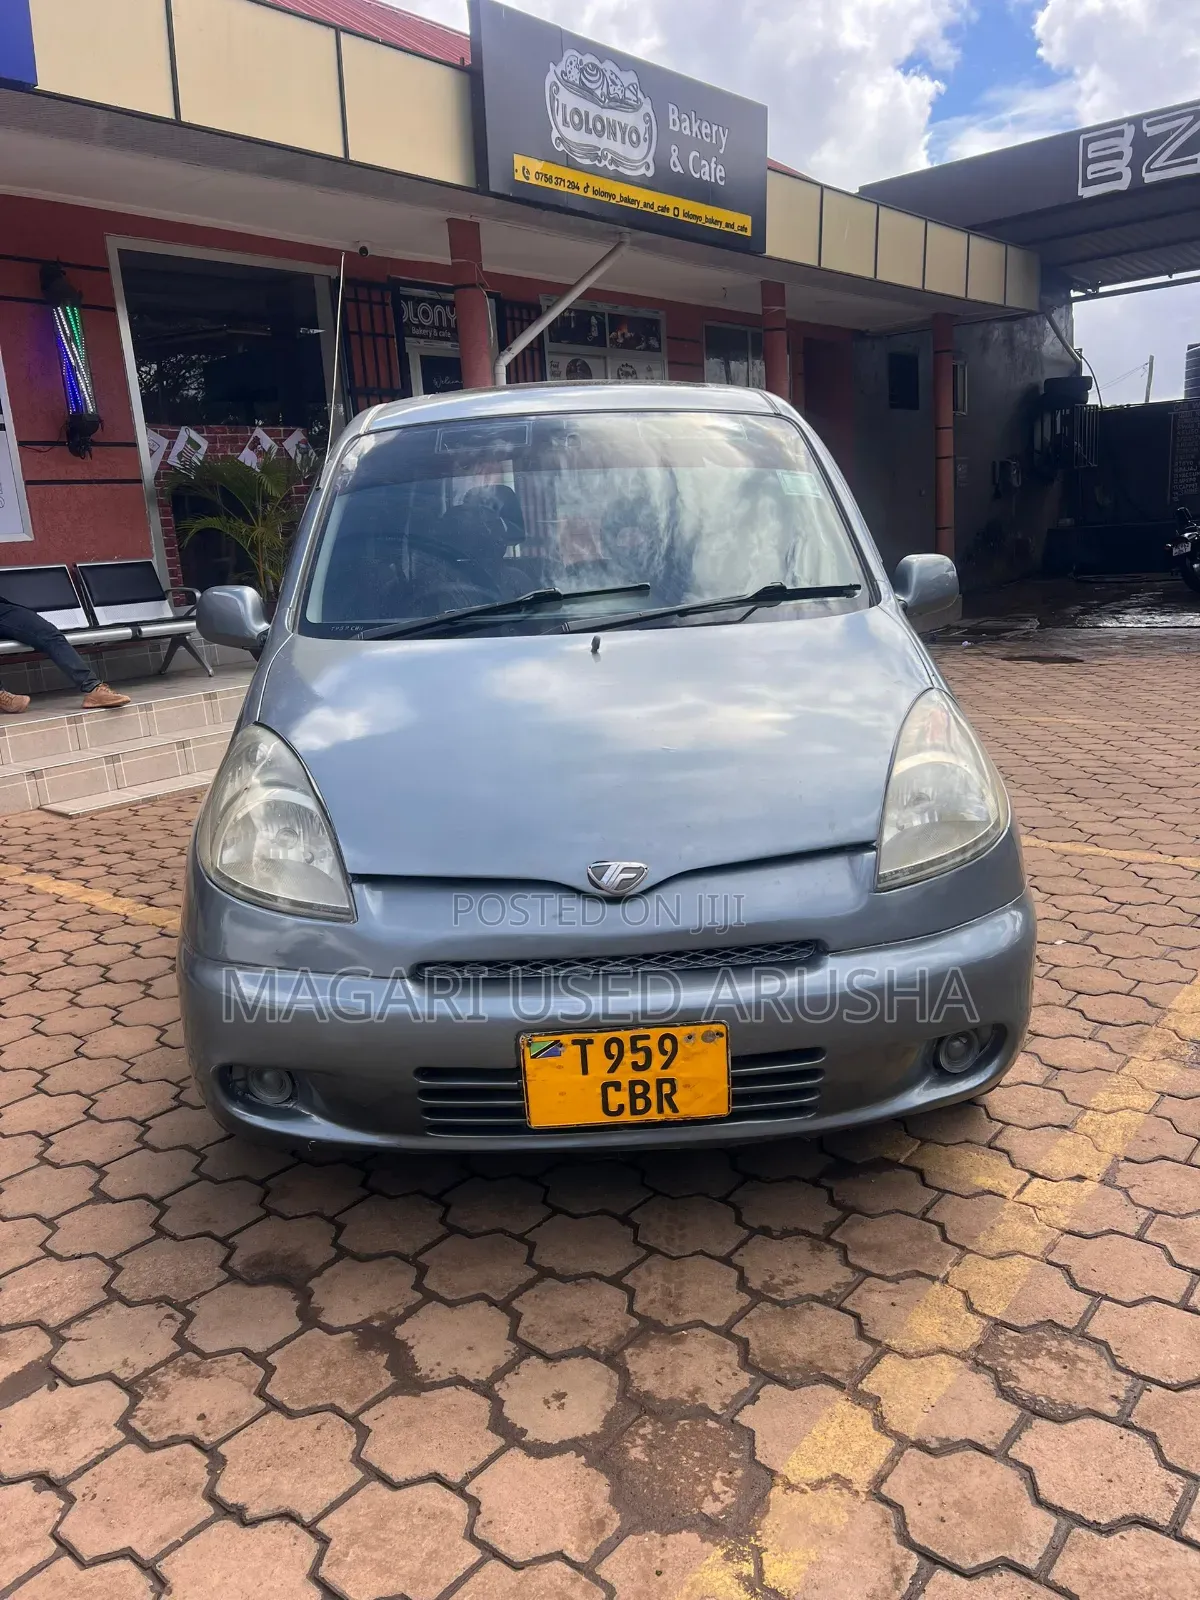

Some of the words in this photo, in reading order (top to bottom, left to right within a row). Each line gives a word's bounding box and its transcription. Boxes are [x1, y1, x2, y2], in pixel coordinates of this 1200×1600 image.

[561, 103, 641, 149] LOLONYO
[668, 102, 729, 153] Bakery
[669, 143, 685, 175] &
[688, 150, 727, 186] Cafe
[554, 176, 566, 188] 371
[592, 186, 670, 214] lolonyo_bakery_and_cafe
[683, 208, 749, 233] lolonyo_bakery_and_cafe
[411, 326, 433, 338] Bakery
[433, 328, 438, 337] &
[438, 329, 451, 338] cafe
[571, 1038, 594, 1076] T
[603, 1032, 679, 1074] 959
[600, 1077, 680, 1117] CBR
